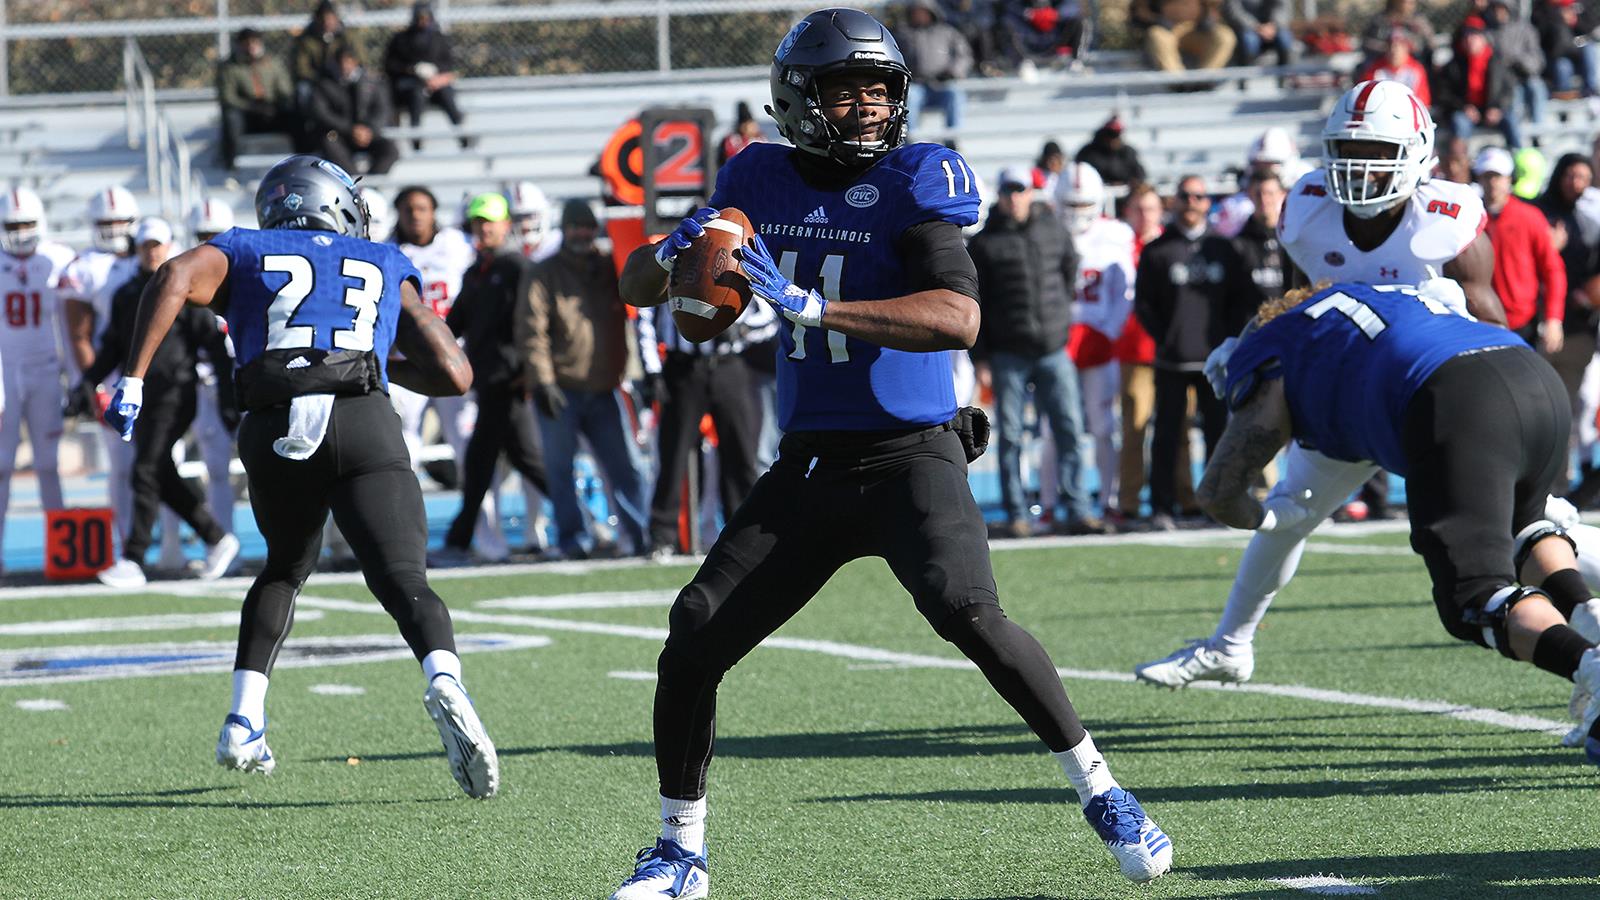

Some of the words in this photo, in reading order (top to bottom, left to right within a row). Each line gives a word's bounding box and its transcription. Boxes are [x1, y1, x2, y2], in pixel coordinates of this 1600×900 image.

[653, 121, 704, 187] 2
[852, 191, 873, 201] OVC
[941, 159, 970, 198] 11
[803, 216, 829, 224] adidas
[1427, 199, 1461, 220] 2
[760, 223, 813, 239] EASTERN
[815, 228, 872, 243] ILLINOIS
[262, 254, 384, 352] 23
[776, 250, 850, 364] 11
[51, 518, 107, 569] 30
